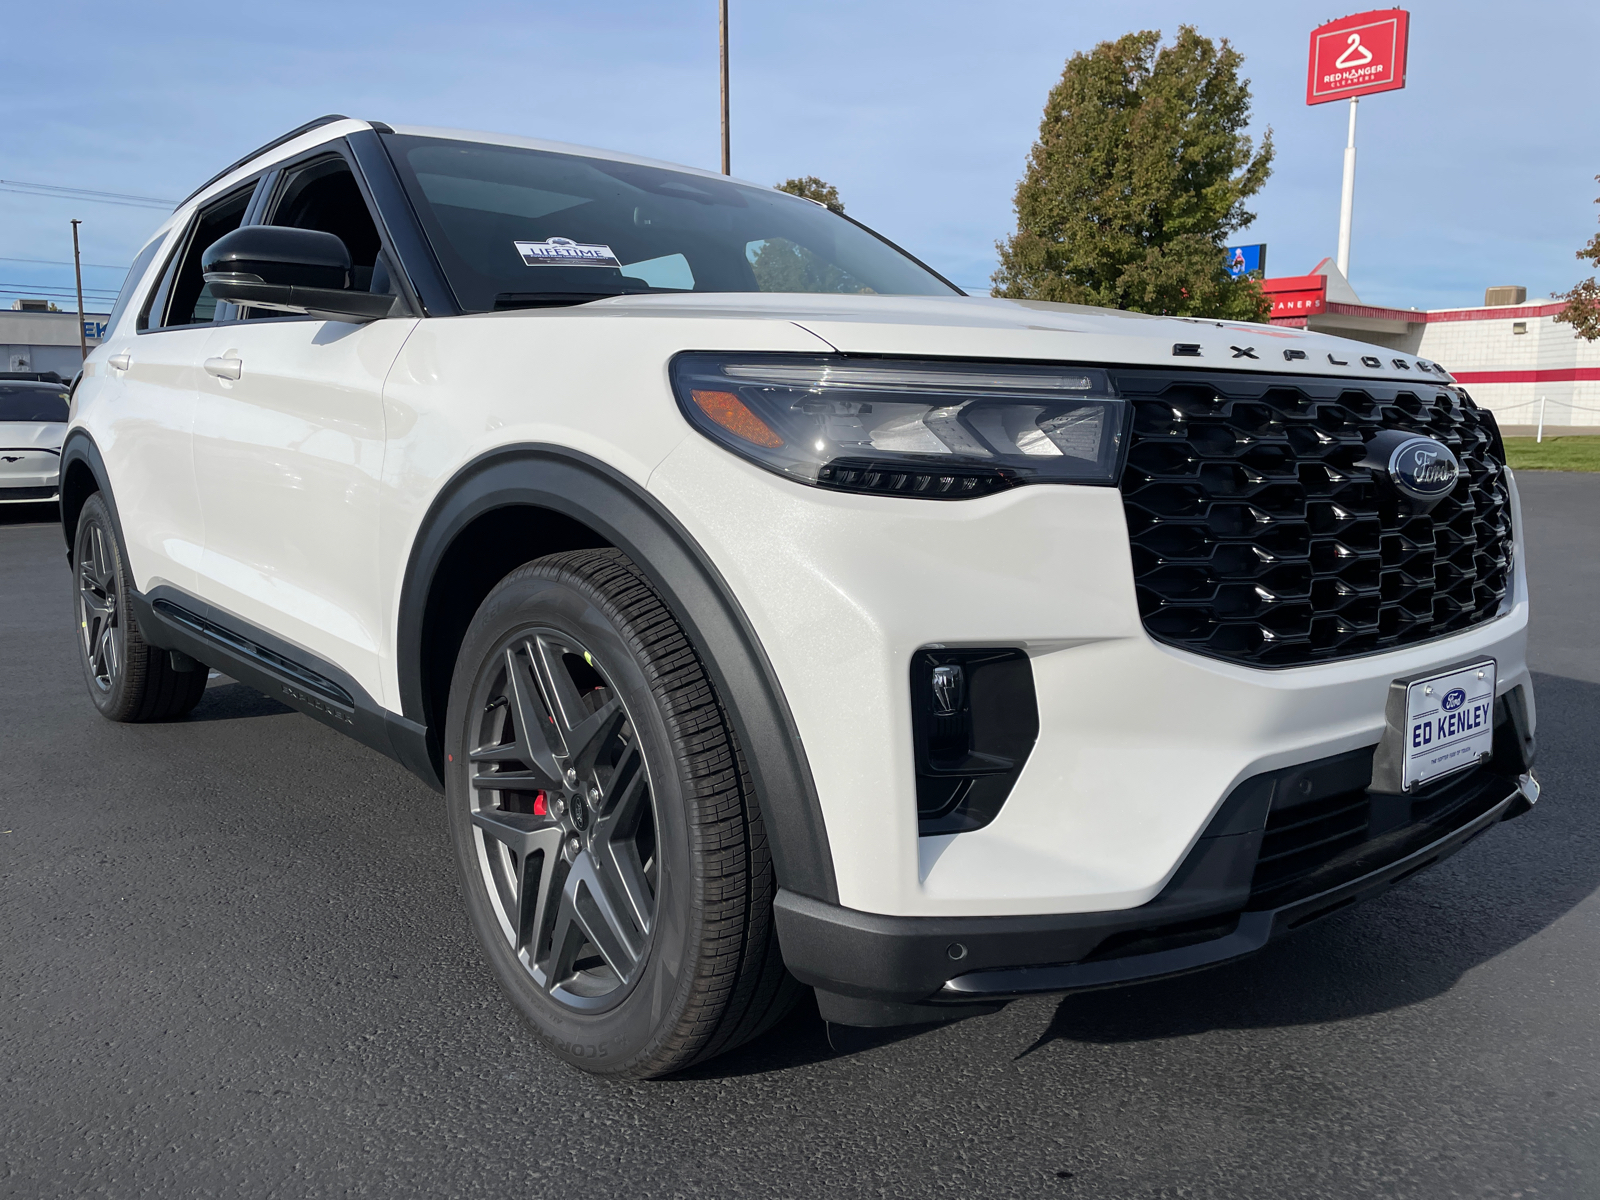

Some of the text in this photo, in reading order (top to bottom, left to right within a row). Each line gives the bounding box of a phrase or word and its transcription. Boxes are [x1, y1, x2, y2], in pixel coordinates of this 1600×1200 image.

[1324, 64, 1384, 84] RED HANGER
[1330, 74, 1375, 88] CLEANERS
[530, 248, 604, 257] LIFETIME
[1171, 343, 1447, 374] EXPLORER
[1413, 450, 1454, 482] Ford
[1445, 692, 1462, 709] Ford
[1412, 702, 1490, 748] ED KENLEY
